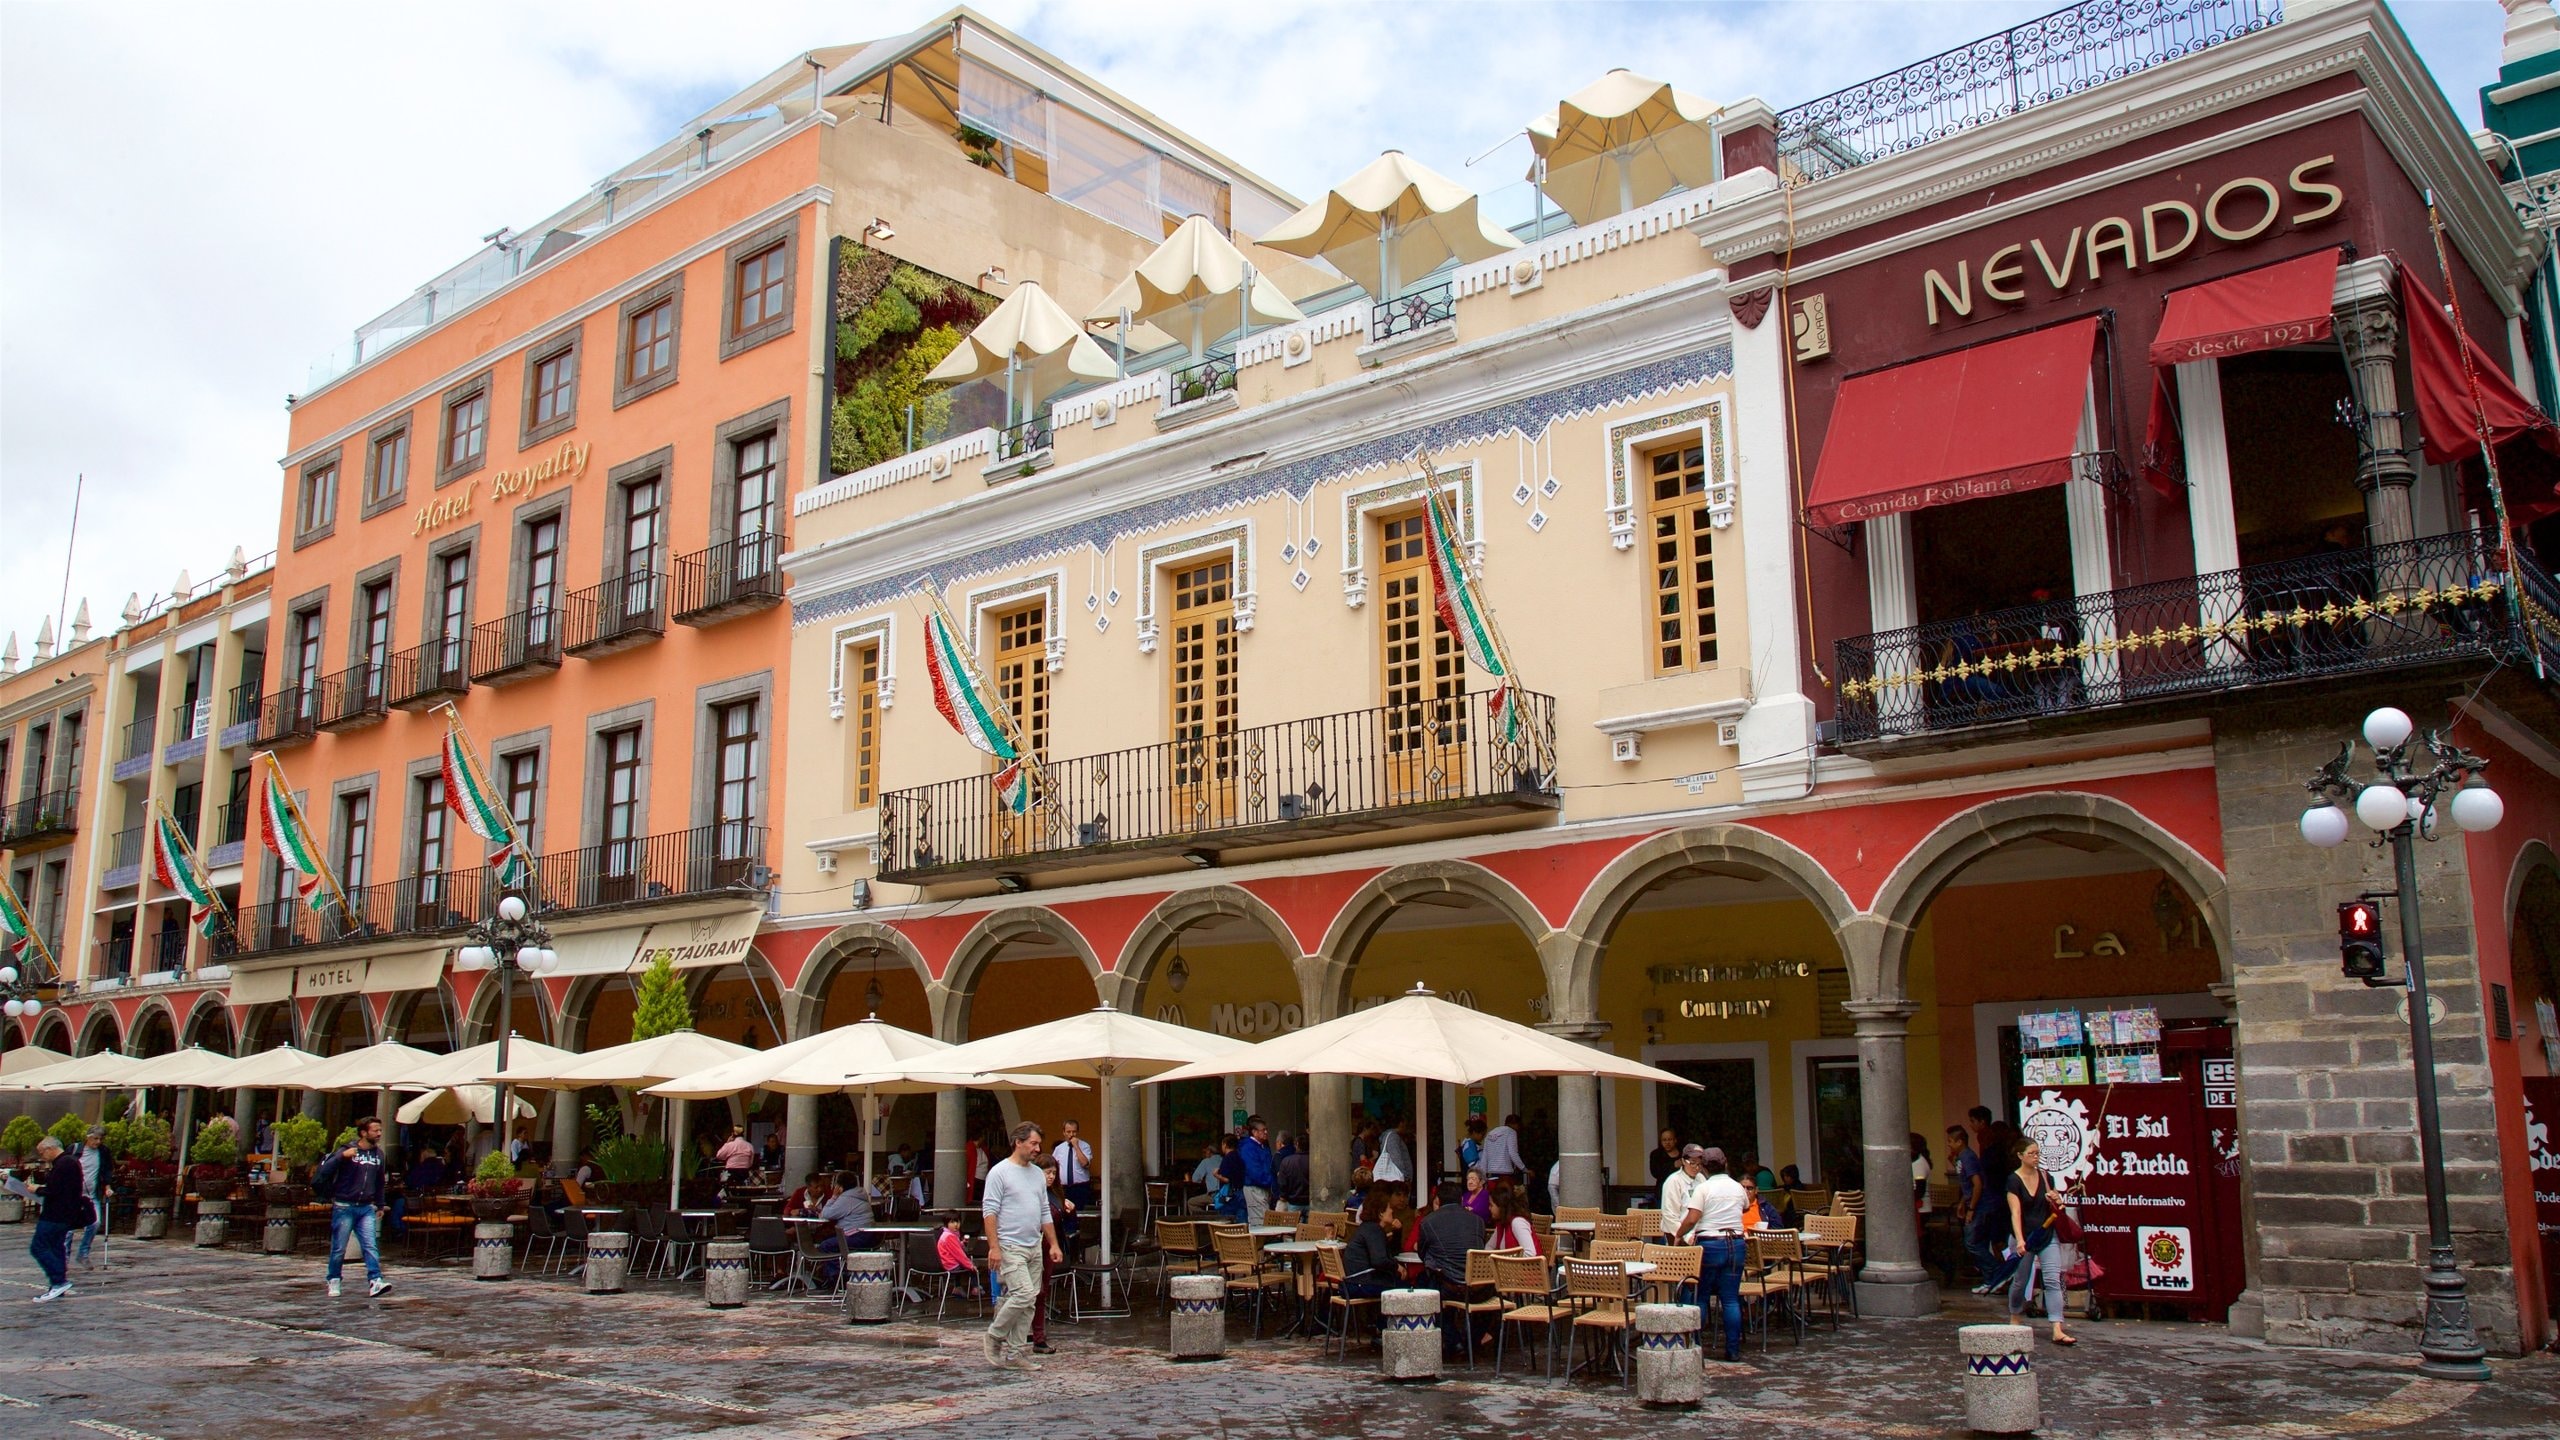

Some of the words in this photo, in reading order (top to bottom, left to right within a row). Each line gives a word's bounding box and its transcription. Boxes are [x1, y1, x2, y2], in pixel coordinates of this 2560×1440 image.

[1923, 154, 2344, 326] NEVADOS
[1813, 294, 1827, 350] NEVADOS
[2187, 335, 2250, 358] desde
[2263, 323, 2317, 345] 1921
[411, 479, 480, 538] Hotel
[490, 440, 592, 501] Royalty
[1839, 493, 1919, 520] Comida
[1924, 477, 2013, 502] Poblana
[639, 937, 751, 964] RESTAURANT
[2054, 923, 2127, 959] La
[308, 970, 353, 988] HOTEL
[1679, 999, 1771, 1020] Company
[2025, 1064, 2046, 1086] 25
[2210, 1092, 2226, 1105] DE
[2105, 1114, 2131, 1139] El
[2135, 1113, 2171, 1139] Sol
[2095, 1152, 2120, 1177] de
[2121, 1151, 2190, 1176] Puebla
[2059, 1192, 2096, 1206] Máxmo
[2097, 1193, 2127, 1206] Poder
[2127, 1194, 2186, 1207] Informativo
[2146, 1275, 2190, 1288] OEM
